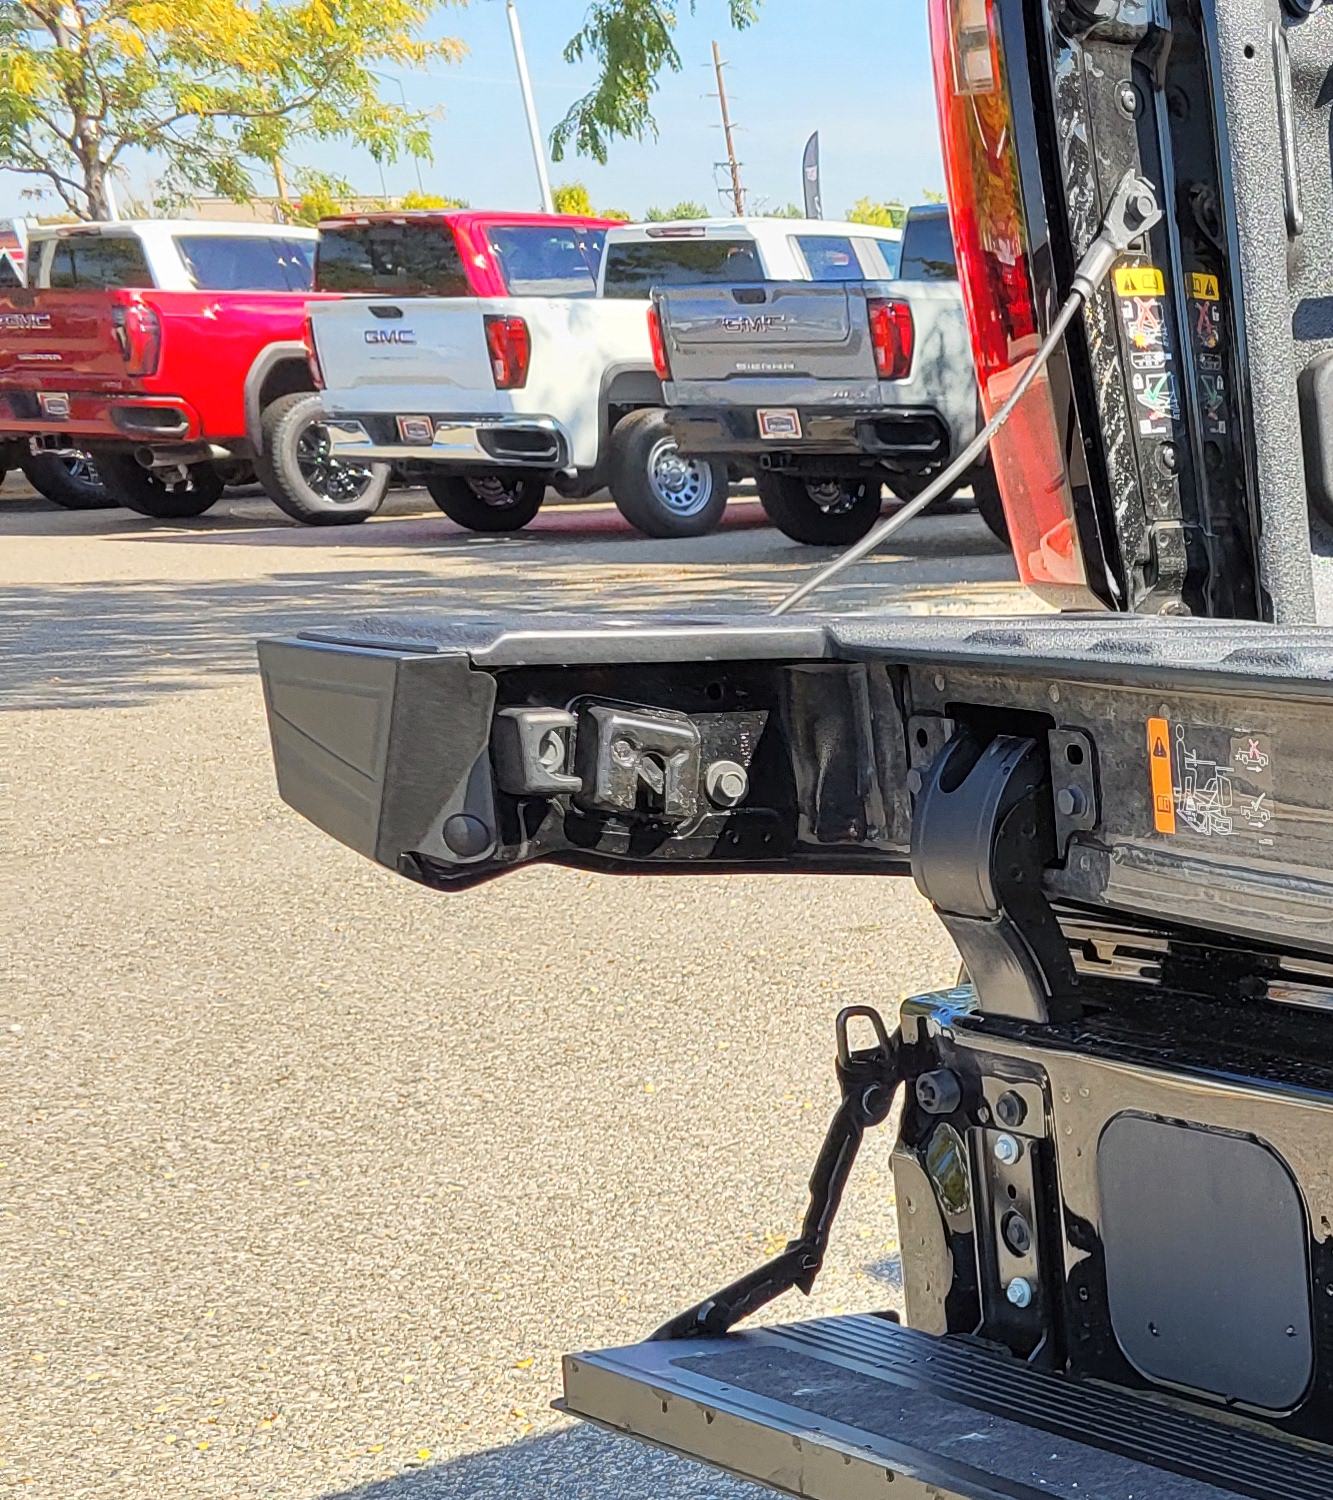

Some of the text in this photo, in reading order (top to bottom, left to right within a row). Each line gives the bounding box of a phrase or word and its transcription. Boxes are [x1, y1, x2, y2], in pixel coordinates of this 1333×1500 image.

[3, 313, 52, 329] GMC
[722, 314, 788, 333] GMC
[364, 329, 417, 344] GMC
